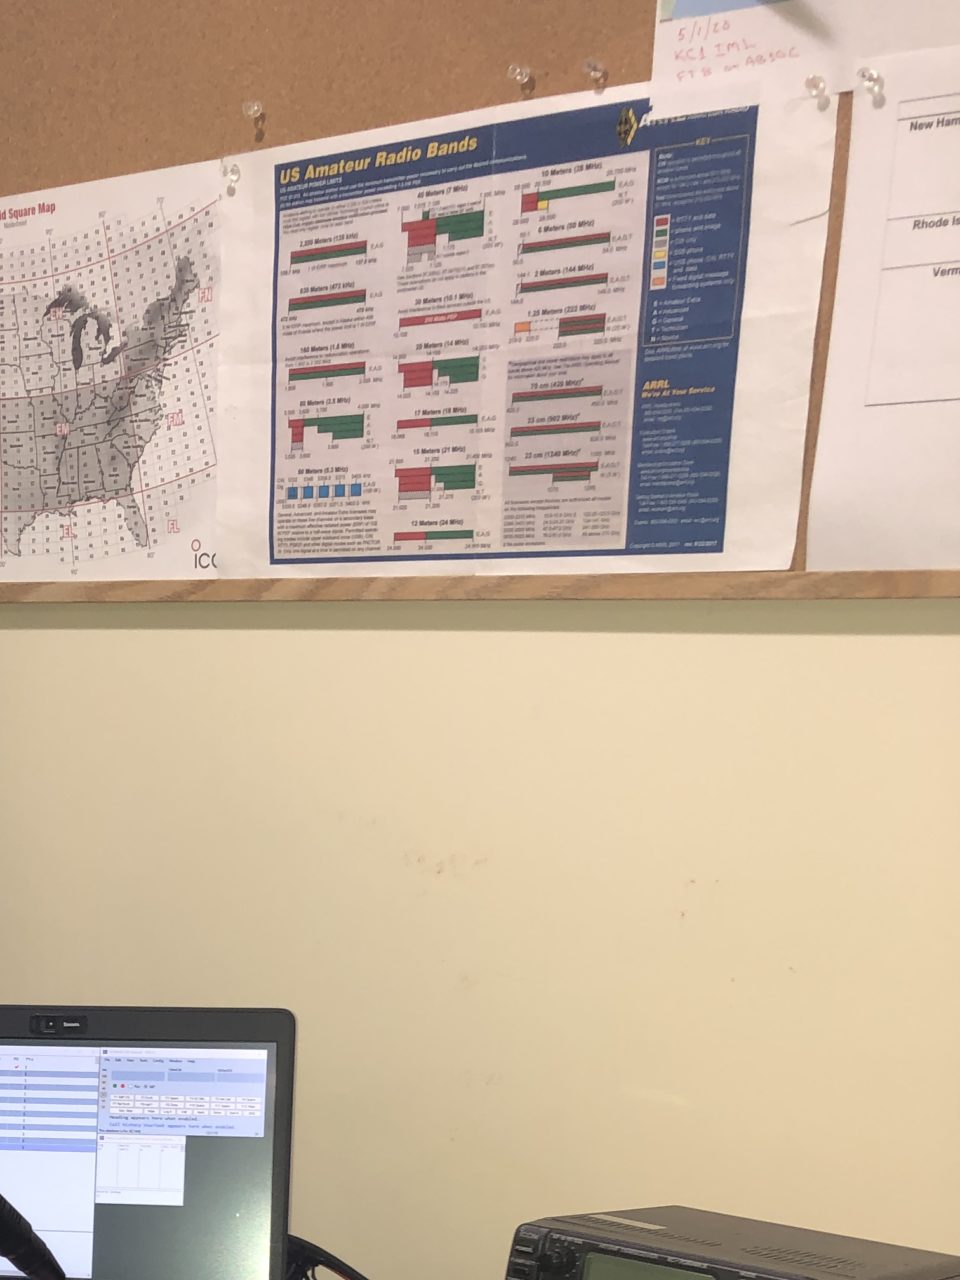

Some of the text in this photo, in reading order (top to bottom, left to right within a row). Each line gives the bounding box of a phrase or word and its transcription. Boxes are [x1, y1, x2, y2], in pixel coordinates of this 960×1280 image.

[910, 120, 933, 131] New
[280, 135, 478, 184] US Amateur Radio Bands
[551, 168, 572, 176] Meters
[586, 163, 602, 172] MHz)
[9, 205, 36, 220] Square
[38, 202, 56, 214] Map
[544, 224, 565, 233] Meters
[578, 220, 595, 228] MHz)
[912, 217, 949, 230] Rhode
[315, 237, 332, 245] Meters
[540, 268, 561, 277] Meters
[577, 264, 594, 273] MHz)
[933, 267, 960, 277] Verm
[310, 284, 329, 292] Meters
[423, 297, 442, 305] Meters
[458, 292, 474, 300] MHz)
[542, 308, 563, 316] Meters
[578, 304, 596, 313] MHz)
[424, 342, 443, 350] Meters
[643, 379, 670, 390] ARRL
[688, 386, 716, 395] Service
[422, 408, 441, 416] Meters
[452, 406, 467, 414] MHz)
[167, 412, 185, 426] FM
[56, 424, 70, 436] EM
[167, 519, 180, 533] FL
[450, 518, 464, 526] MHz)
[62, 525, 75, 539] EL
